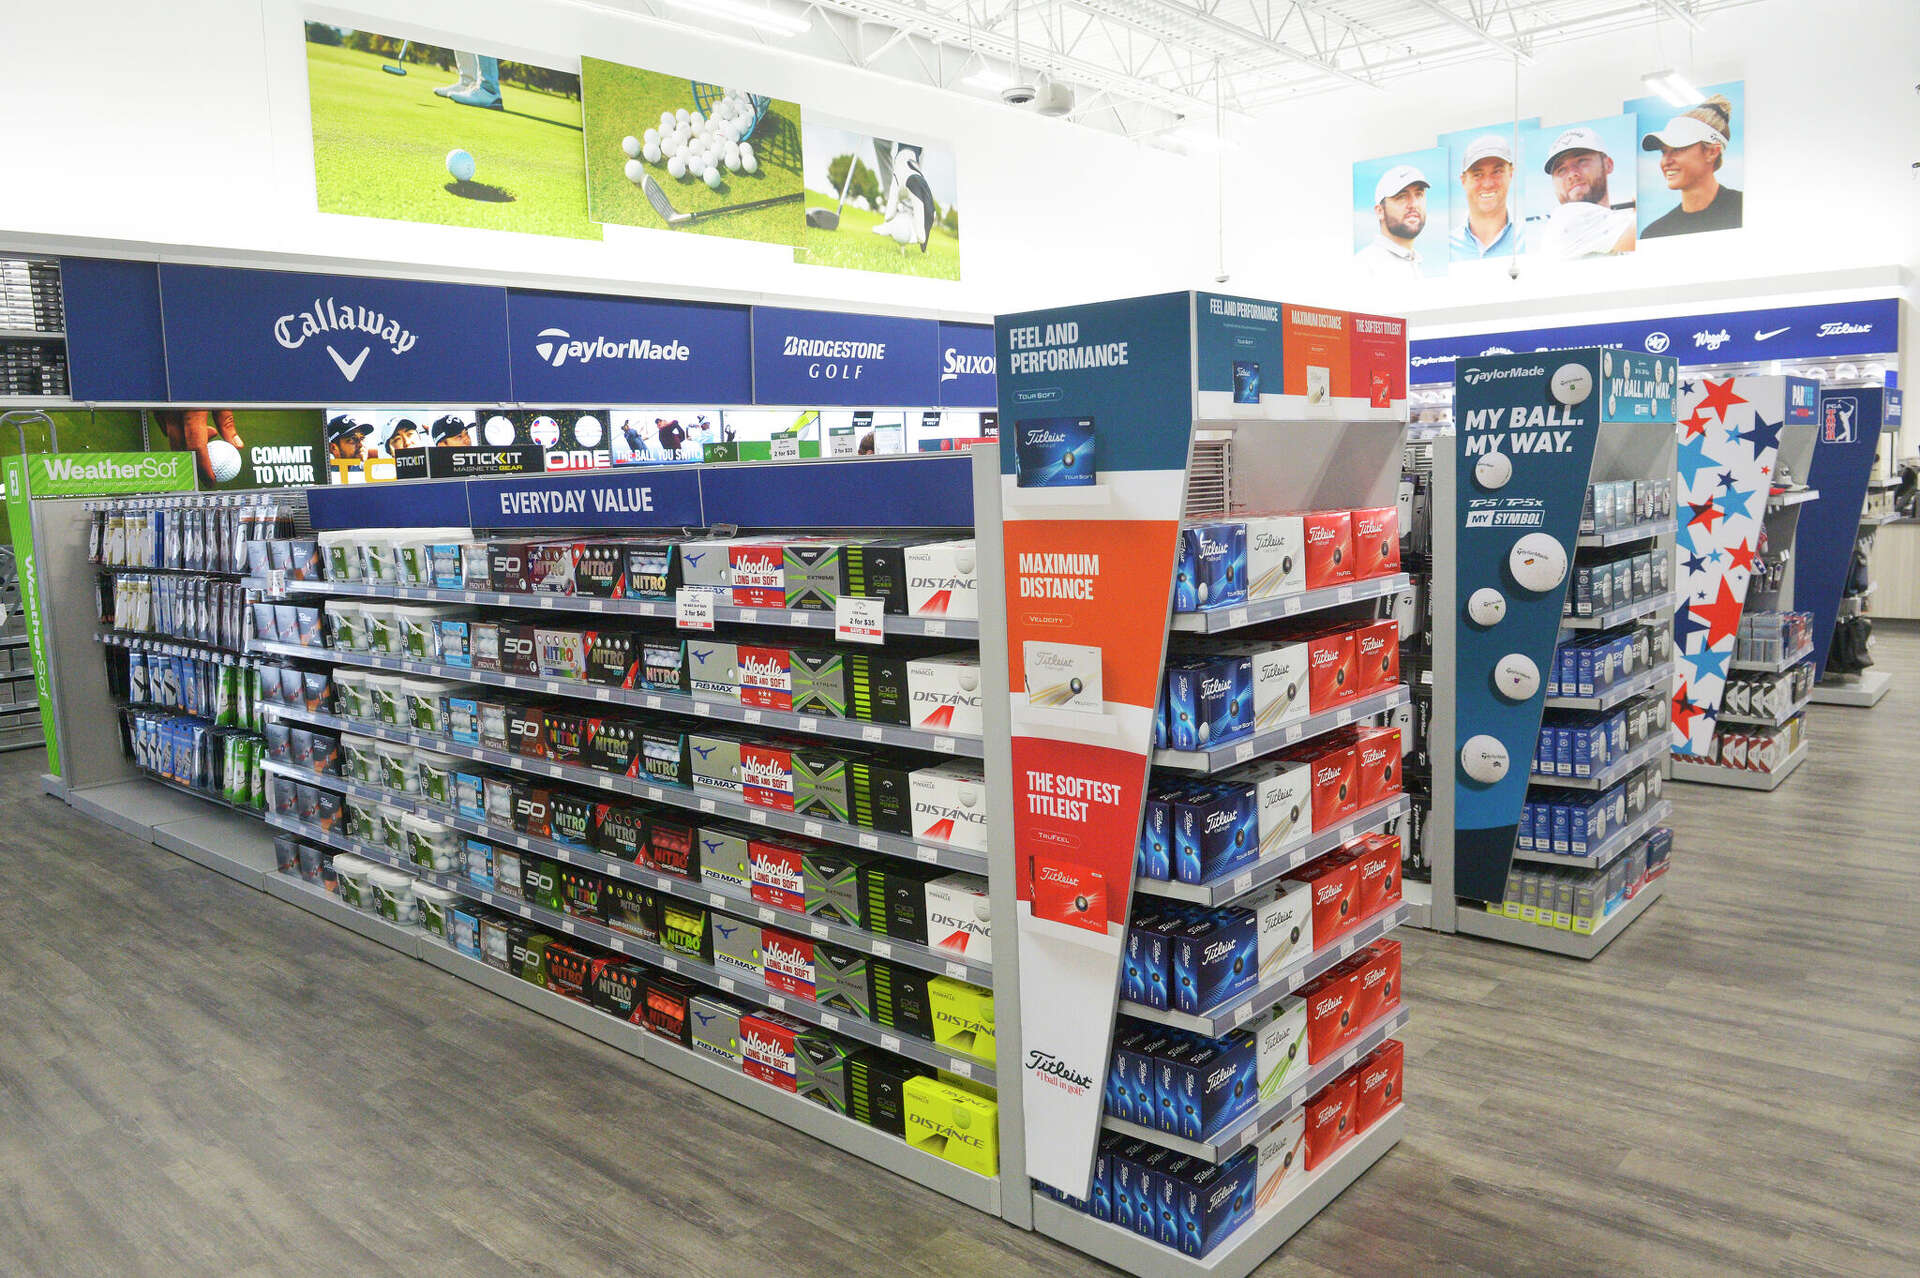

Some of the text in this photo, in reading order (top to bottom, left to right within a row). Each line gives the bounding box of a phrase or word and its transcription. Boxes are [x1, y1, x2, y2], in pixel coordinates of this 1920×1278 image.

[1210, 298, 1279, 322] FEEL AND PERFORMANCE
[1291, 309, 1342, 330] MAXIMUM DISTANCE
[274, 296, 418, 354] Callaway
[1010, 321, 1079, 350] FEEL AND
[1356, 319, 1365, 333] THE
[1816, 321, 1873, 338] Titleist
[535, 327, 690, 368] TaylorMade
[783, 335, 886, 360] BRIDGESTONE
[1693, 329, 1731, 350] Waggle
[1010, 342, 1129, 375] PERFORMANCE
[808, 362, 865, 380] GOLF
[1464, 366, 1545, 386] TaylorMade
[1612, 378, 1624, 397] MY
[1644, 380, 1655, 399] MY
[1464, 403, 1584, 431] MY BALL.
[1025, 428, 1067, 446] Titleist
[1464, 430, 1573, 457] MY WAY.
[251, 446, 313, 465] COMMIT
[452, 452, 523, 466] STICKIT
[635, 448, 656, 461] BALL
[43, 457, 179, 481] WeatherSof
[253, 465, 315, 484] TO YOUR
[453, 465, 498, 473] MAGNETIC
[500, 487, 654, 514] EVERYDAY VALUE
[1357, 520, 1383, 537] Titleist
[1472, 512, 1542, 525] MY SYMBOL
[1255, 532, 1286, 551] Titleist
[1307, 525, 1336, 544] Titleist
[494, 556, 521, 573] 50
[534, 560, 565, 577] NITRO
[580, 560, 614, 576] NITRO
[736, 554, 776, 574] Noodle
[1019, 553, 1100, 576] MAXIMUM
[633, 574, 667, 591] NITRO
[734, 575, 778, 586] LONG AND SOFT
[911, 575, 977, 590] DISTANC
[1020, 576, 1094, 600] DISTANCE
[24, 555, 50, 700] WeatherSof
[855, 617, 863, 625] for
[1029, 615, 1063, 624] VELOCITY
[504, 638, 533, 654] 50
[543, 645, 574, 662] NITRO
[1360, 637, 1385, 655] Titleist
[592, 649, 625, 665] NITRO
[744, 655, 783, 675] Noodle
[1034, 651, 1075, 668] Titleist
[1311, 649, 1339, 668] Titleist
[646, 666, 681, 685] NITRO
[743, 675, 758, 684] LONG
[770, 677, 785, 688] SOFT
[1259, 663, 1290, 682] Titleist
[711, 684, 733, 693] MAX
[1200, 678, 1232, 701] Titleist
[510, 719, 539, 738] 50
[550, 730, 580, 747] NITRO
[595, 736, 629, 755] NITRO
[646, 757, 680, 777] NITRO
[745, 755, 786, 777] Noodle
[1361, 748, 1387, 768] Titleist
[713, 779, 737, 790] MAX
[744, 774, 760, 785] LONG
[772, 778, 788, 790] SOFT
[1316, 766, 1341, 788] Titleist
[1027, 770, 1122, 806] THE SOFTEST
[1265, 787, 1293, 809] Titleist
[517, 799, 546, 818] 50
[915, 802, 987, 825] DISTANCE
[1027, 793, 1089, 823] TITLEIST
[555, 811, 586, 832] NITRO
[604, 821, 637, 843] NITRO
[1204, 810, 1238, 835] Titleist
[654, 847, 688, 869] NITRO
[756, 853, 796, 879] Noodle
[721, 874, 743, 886] MAX
[1040, 866, 1079, 887] Titleist
[1362, 859, 1387, 880] Titleist
[526, 870, 553, 891] 50
[567, 884, 597, 905] NITRO
[1316, 882, 1343, 905] Titleist
[1264, 909, 1293, 933] Titleist
[667, 927, 701, 950] NITRO
[512, 945, 540, 966] 50
[768, 940, 807, 967] Noodle
[1202, 939, 1237, 966] Titleist
[552, 964, 584, 985] NITRO
[766, 958, 782, 970] LONG
[794, 965, 810, 979] SOFT
[1363, 967, 1388, 989] Titleist
[599, 978, 632, 1001] NITRO
[1315, 994, 1343, 1020] Titleist
[649, 1010, 683, 1035] NITRO
[747, 1030, 786, 1059] Noodle
[1263, 1027, 1291, 1054] Titleist
[1025, 1050, 1093, 1089] Titleist
[1205, 1063, 1238, 1094] Titleist
[1044, 1072, 1058, 1086] ball
[1059, 1081, 1067, 1089] in
[1363, 1068, 1389, 1094] Titleist
[1316, 1101, 1343, 1128] Titleist
[909, 1112, 985, 1150] DISTANCE
[1207, 1180, 1239, 1213] Titleist
